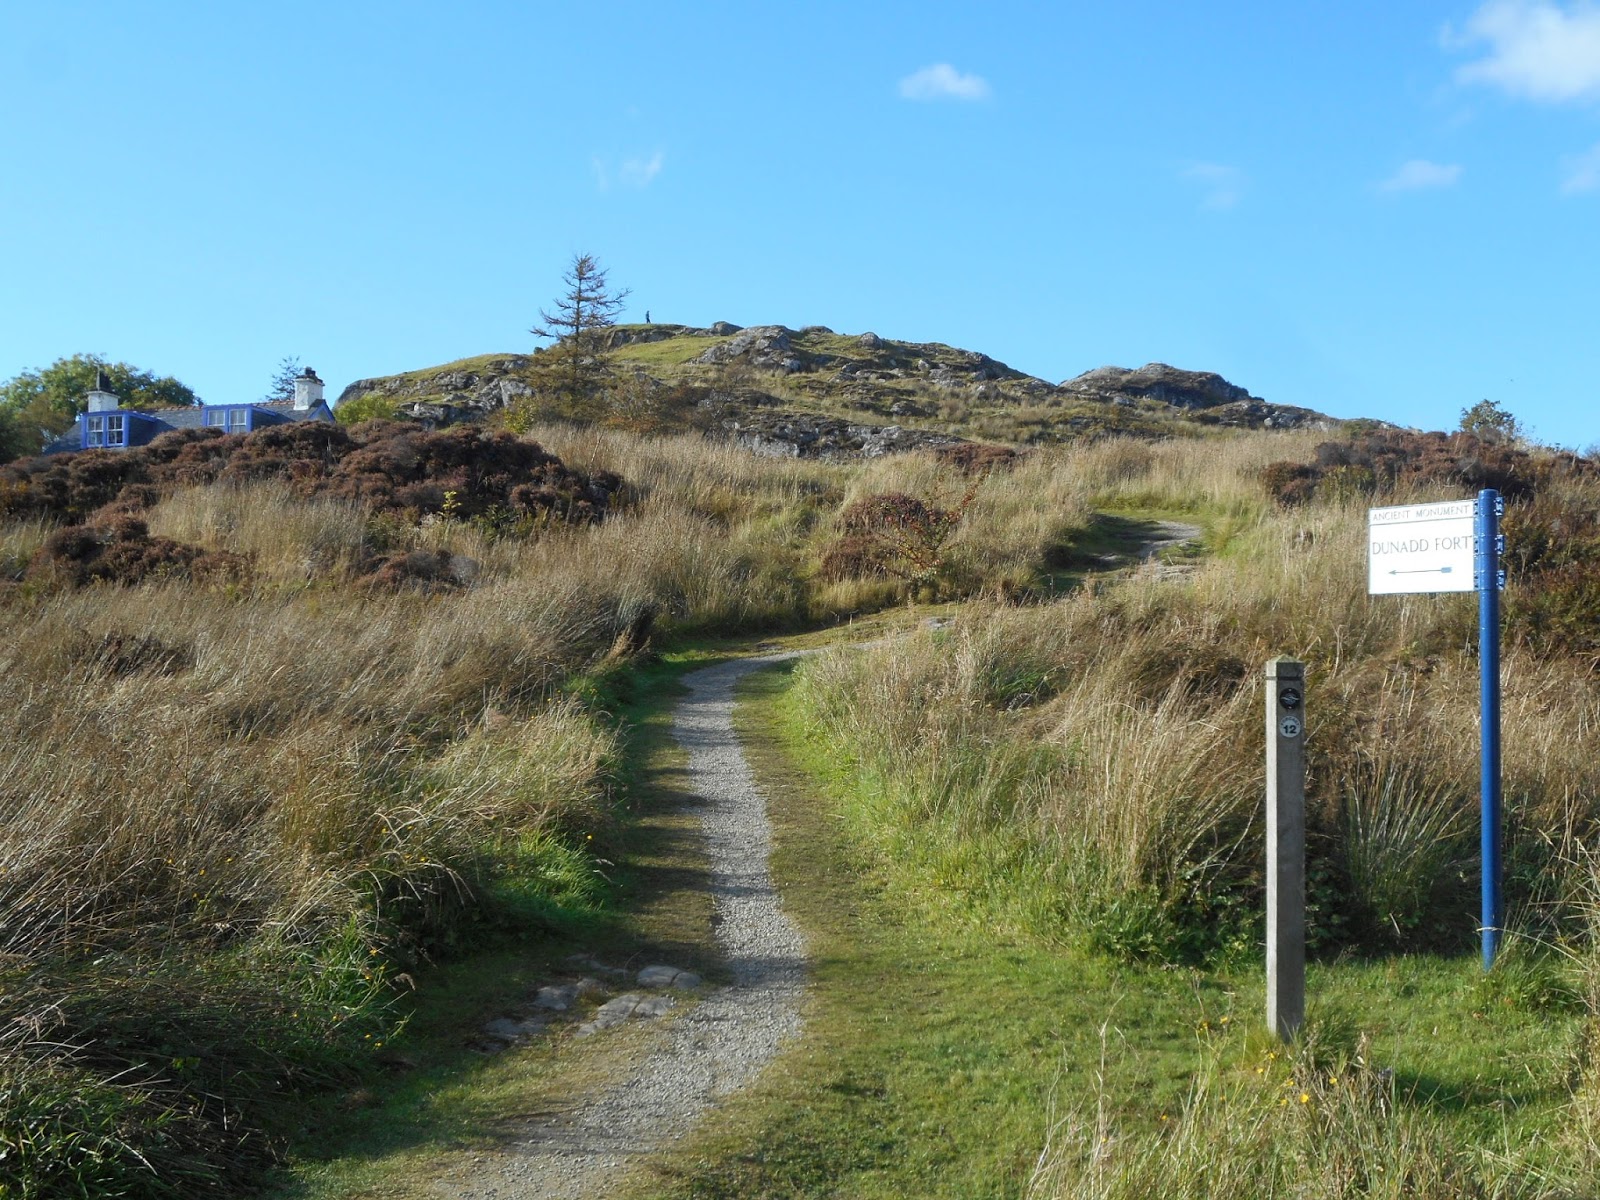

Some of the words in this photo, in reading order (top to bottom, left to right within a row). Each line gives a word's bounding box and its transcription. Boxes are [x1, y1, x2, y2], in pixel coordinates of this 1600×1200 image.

[1373, 509, 1411, 521] ANCIENT
[1415, 504, 1470, 518] MONUMENT
[1372, 538, 1429, 555] DUNADD
[1435, 535, 1472, 551] FORT
[1283, 725, 1297, 734] 12
